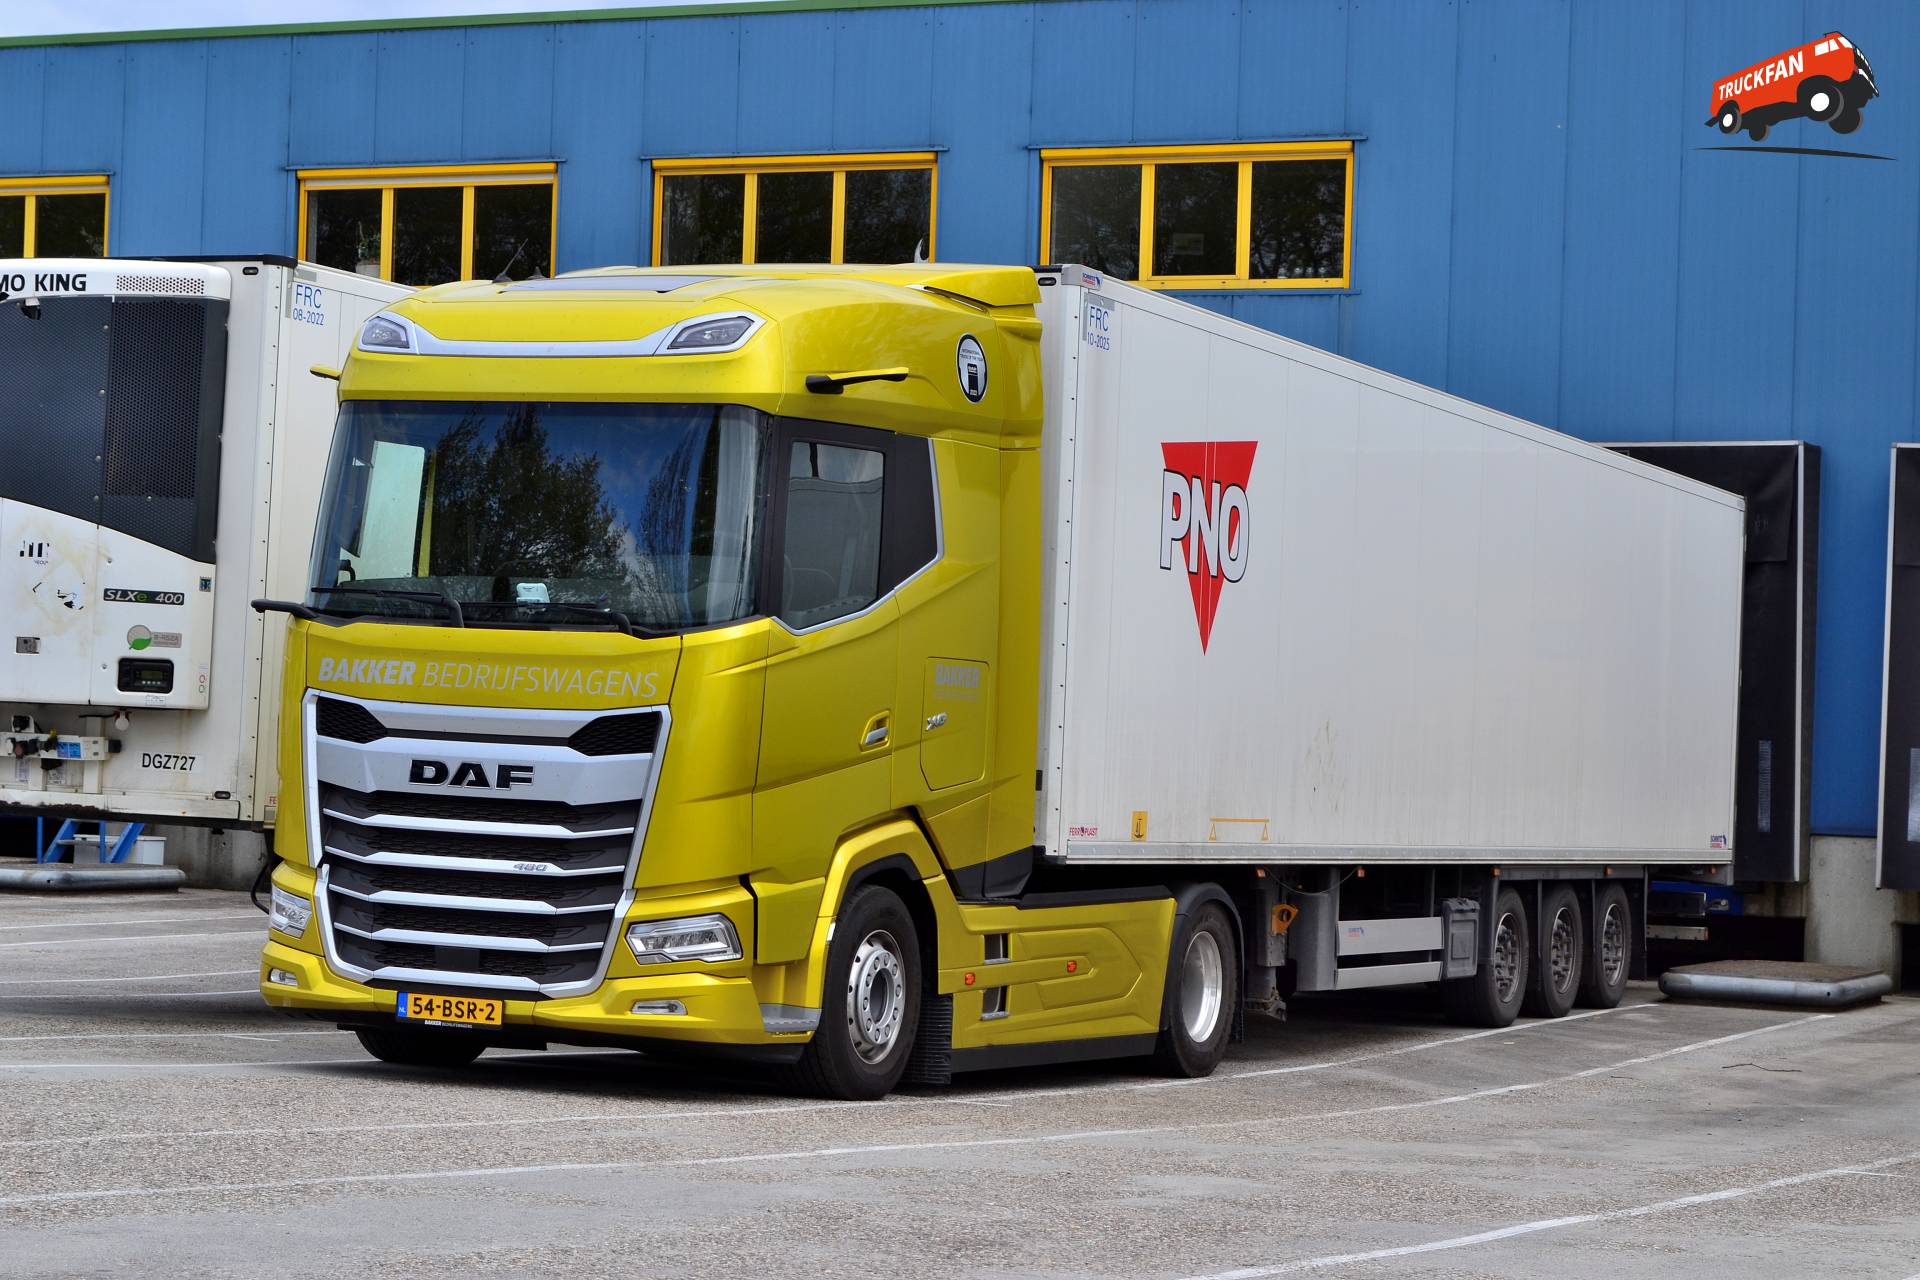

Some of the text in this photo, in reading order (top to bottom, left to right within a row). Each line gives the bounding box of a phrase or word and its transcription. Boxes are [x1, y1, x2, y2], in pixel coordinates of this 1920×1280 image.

[34, 273, 87, 292] KING
[295, 284, 322, 309] FRC
[292, 307, 325, 326] 08-2022
[1089, 305, 1109, 332] FRC
[1087, 331, 1110, 351] 10-2025
[1159, 468, 1250, 583] PNO
[155, 593, 183, 604] 400
[318, 656, 661, 700] BAKKER BEDRIJFSWAGENS
[141, 753, 196, 771] DGZ727
[408, 759, 536, 791] DAF
[513, 863, 548, 872] 480
[413, 997, 496, 1021] 54-BSR-2
